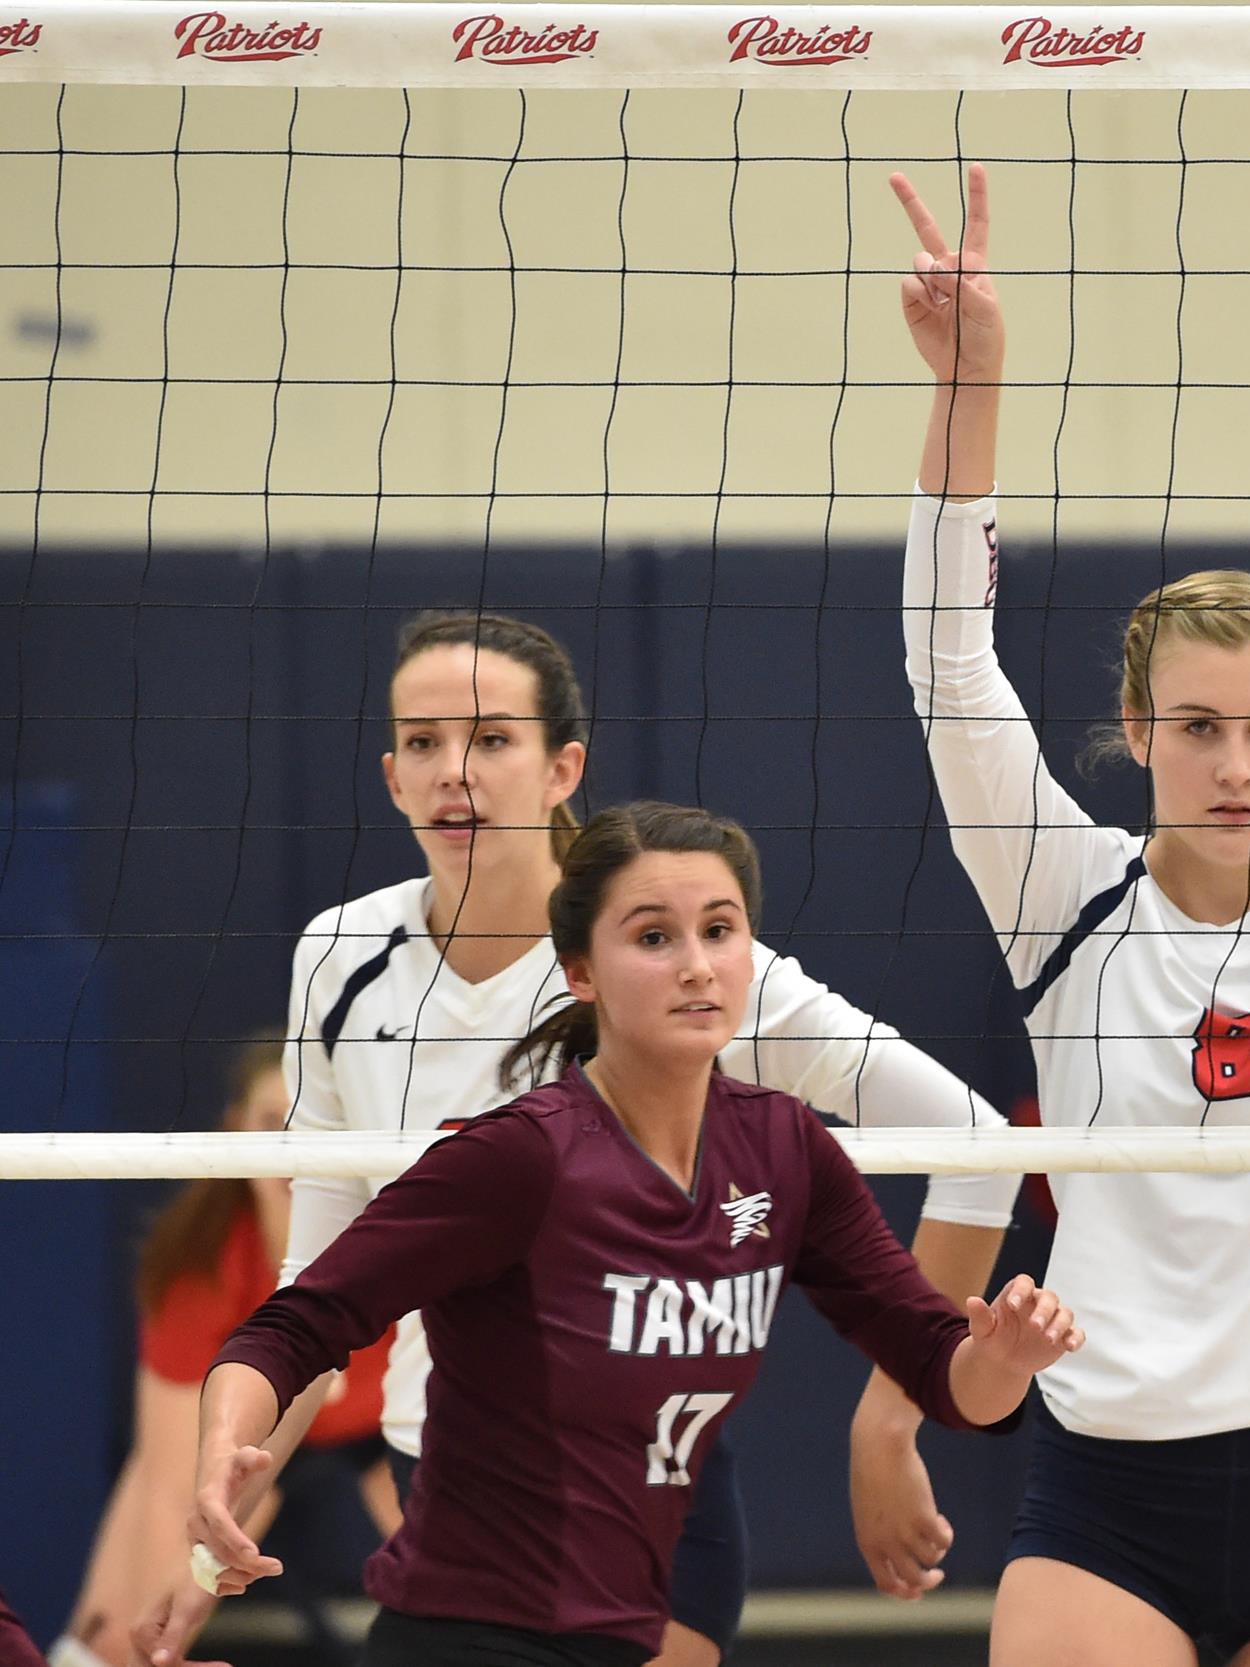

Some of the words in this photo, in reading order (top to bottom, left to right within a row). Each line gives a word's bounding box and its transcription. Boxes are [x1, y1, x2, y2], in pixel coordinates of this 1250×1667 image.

[174, 11, 324, 62] Patriots
[450, 14, 599, 66] Patriots
[726, 15, 874, 67] Patriots
[1000, 16, 1146, 68] Patriots
[603, 1264, 785, 1356] TAMIU
[645, 1391, 736, 1486] 17
